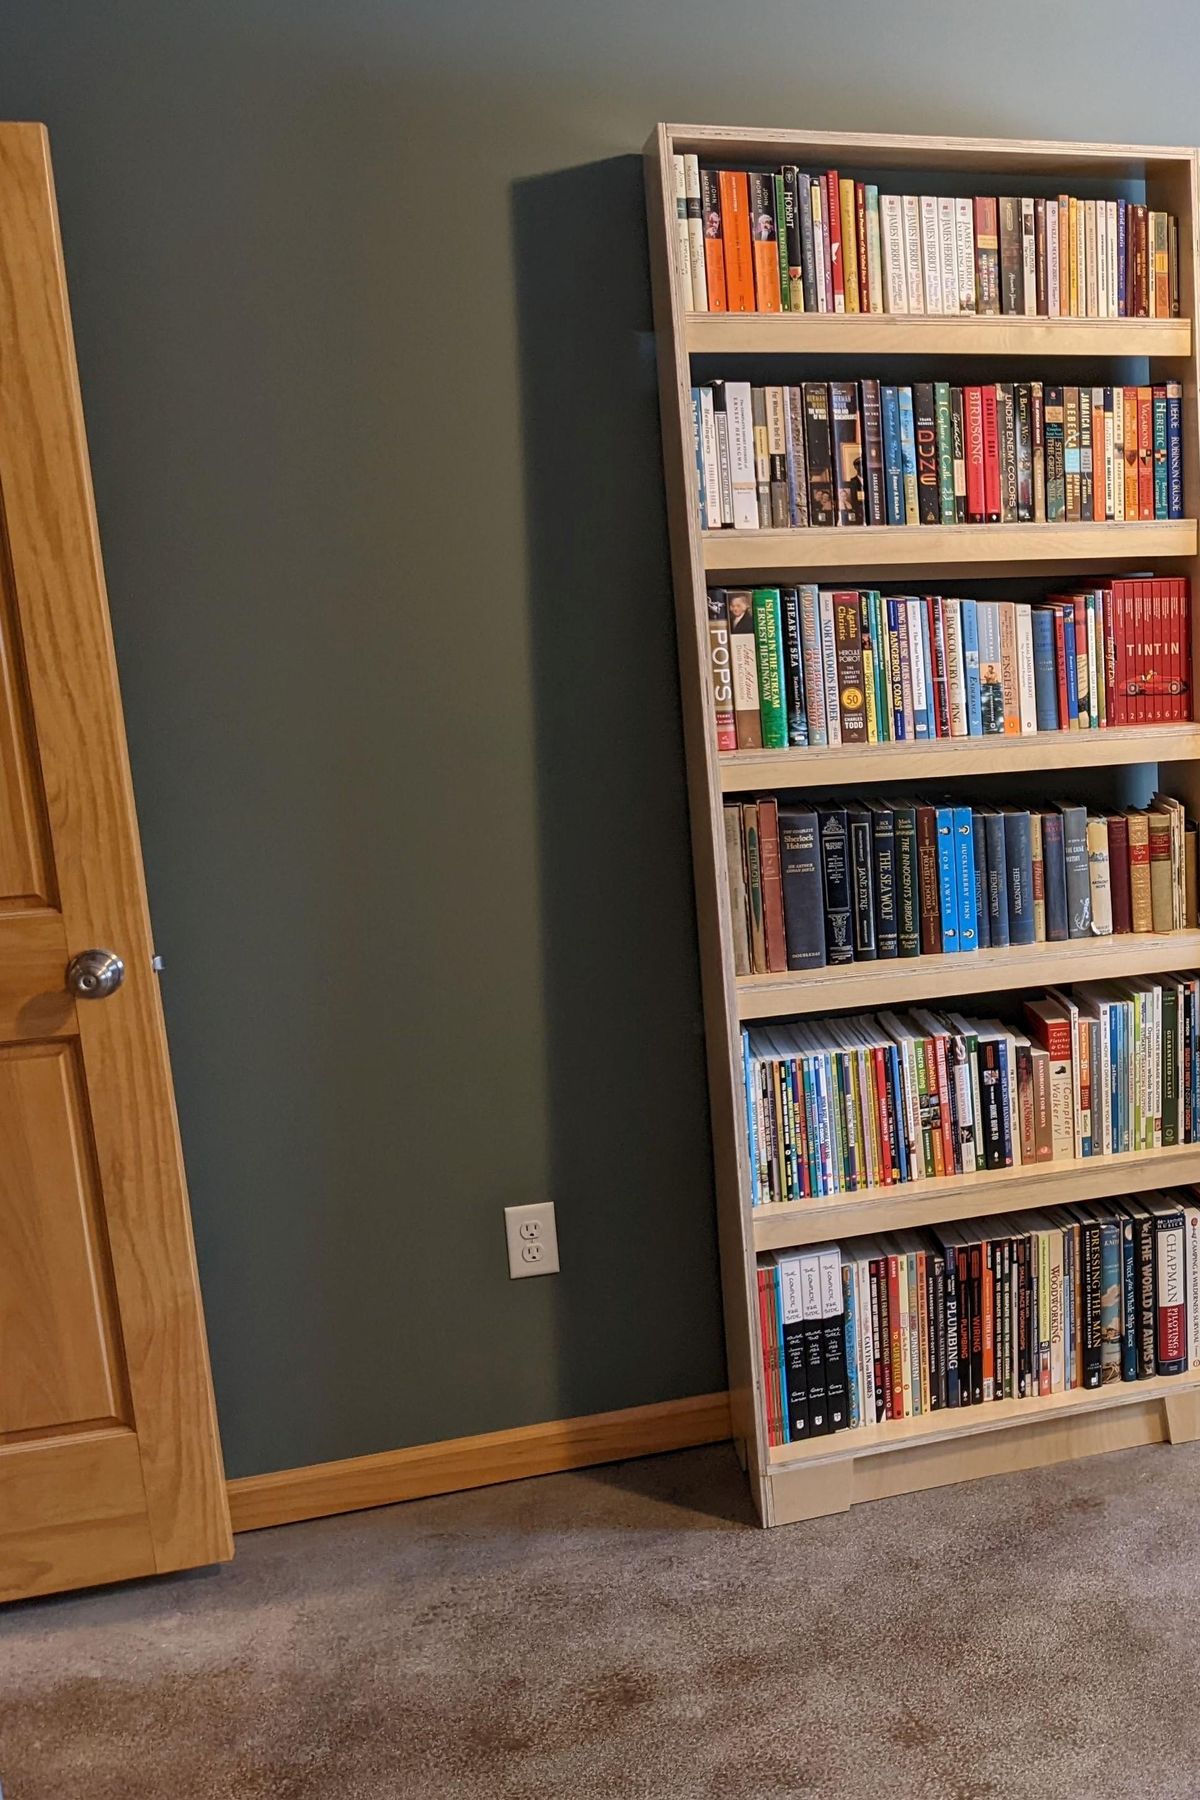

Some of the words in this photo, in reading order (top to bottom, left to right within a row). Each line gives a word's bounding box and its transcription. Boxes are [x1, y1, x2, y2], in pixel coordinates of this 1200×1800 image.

[784, 192, 794, 229] HOBBIT
[970, 392, 982, 464] BIRDSONG
[1081, 393, 1089, 428] JAMAICA
[1141, 403, 1150, 447] VAGABOND
[1156, 402, 1166, 446] HERETIC
[1171, 404, 1179, 428] DEFOE
[1006, 431, 1014, 463] ENEMY
[1082, 431, 1090, 445] INN
[1171, 437, 1180, 477] ROBINSON
[1172, 479, 1181, 511] CRUSOE
[757, 608, 766, 643] ERNEST
[787, 603, 796, 638] HEART
[838, 606, 846, 640] Christie
[848, 608, 857, 638] Agatha
[765, 600, 774, 637] ISLANDS
[771, 672, 780, 707] STREAM
[824, 619, 834, 683] NORTHWOODS
[890, 631, 899, 681] DANGEROUS
[946, 616, 959, 679] BACKCOUNTRY
[1127, 642, 1179, 656] TINTIN
[711, 630, 731, 701] POPS
[760, 646, 771, 701] HEMINGWAY
[828, 686, 838, 721] READER
[894, 684, 902, 711] COAST
[880, 851, 890, 872] THE
[903, 854, 911, 898] INNOCENTS
[881, 874, 891, 892] SEA
[1013, 868, 1021, 914] HEMINGWAY
[882, 894, 893, 920] WOLF
[1091, 1230, 1100, 1288] DRESSING
[1142, 1239, 1151, 1261] THE
[1142, 1264, 1152, 1307] WORLD
[1166, 1234, 1178, 1303] CHAPMAN
[1051, 1265, 1060, 1343] WOODWORKING
[1092, 1290, 1101, 1317] THE
[1143, 1312, 1152, 1325] AT
[948, 1302, 958, 1369] PLUMBING
[1092, 1321, 1101, 1348] MAN
[1144, 1329, 1153, 1361] ARMS
